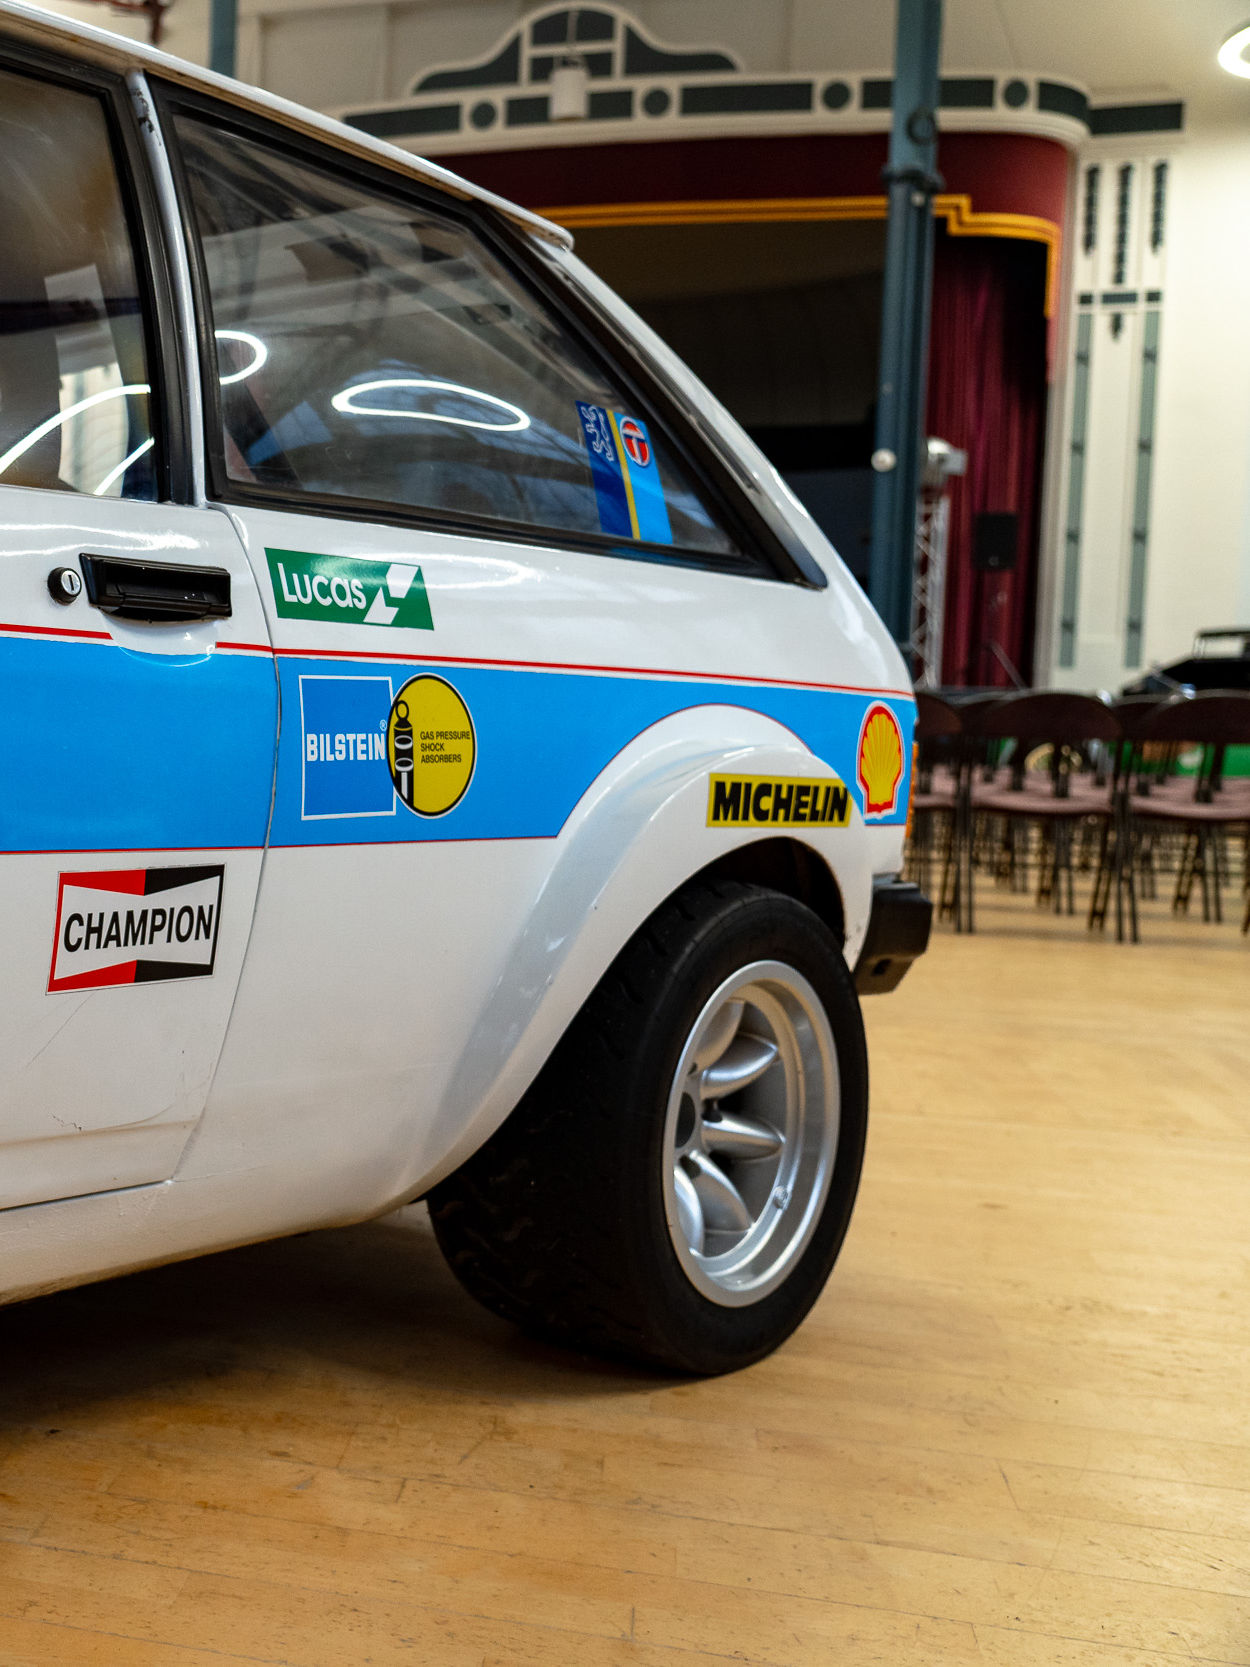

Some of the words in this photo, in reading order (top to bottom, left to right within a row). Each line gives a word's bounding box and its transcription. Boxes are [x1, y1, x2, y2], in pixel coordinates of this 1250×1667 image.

[277, 562, 367, 610] Lucas
[306, 733, 386, 761] BILSTEIN
[420, 731, 435, 740] GAS
[435, 731, 471, 740] PRESSURE
[420, 742, 445, 752] SHOCK
[421, 754, 462, 764] ABSORBERS
[712, 781, 849, 822] MICHELIN
[64, 904, 214, 953] CHAMPION
